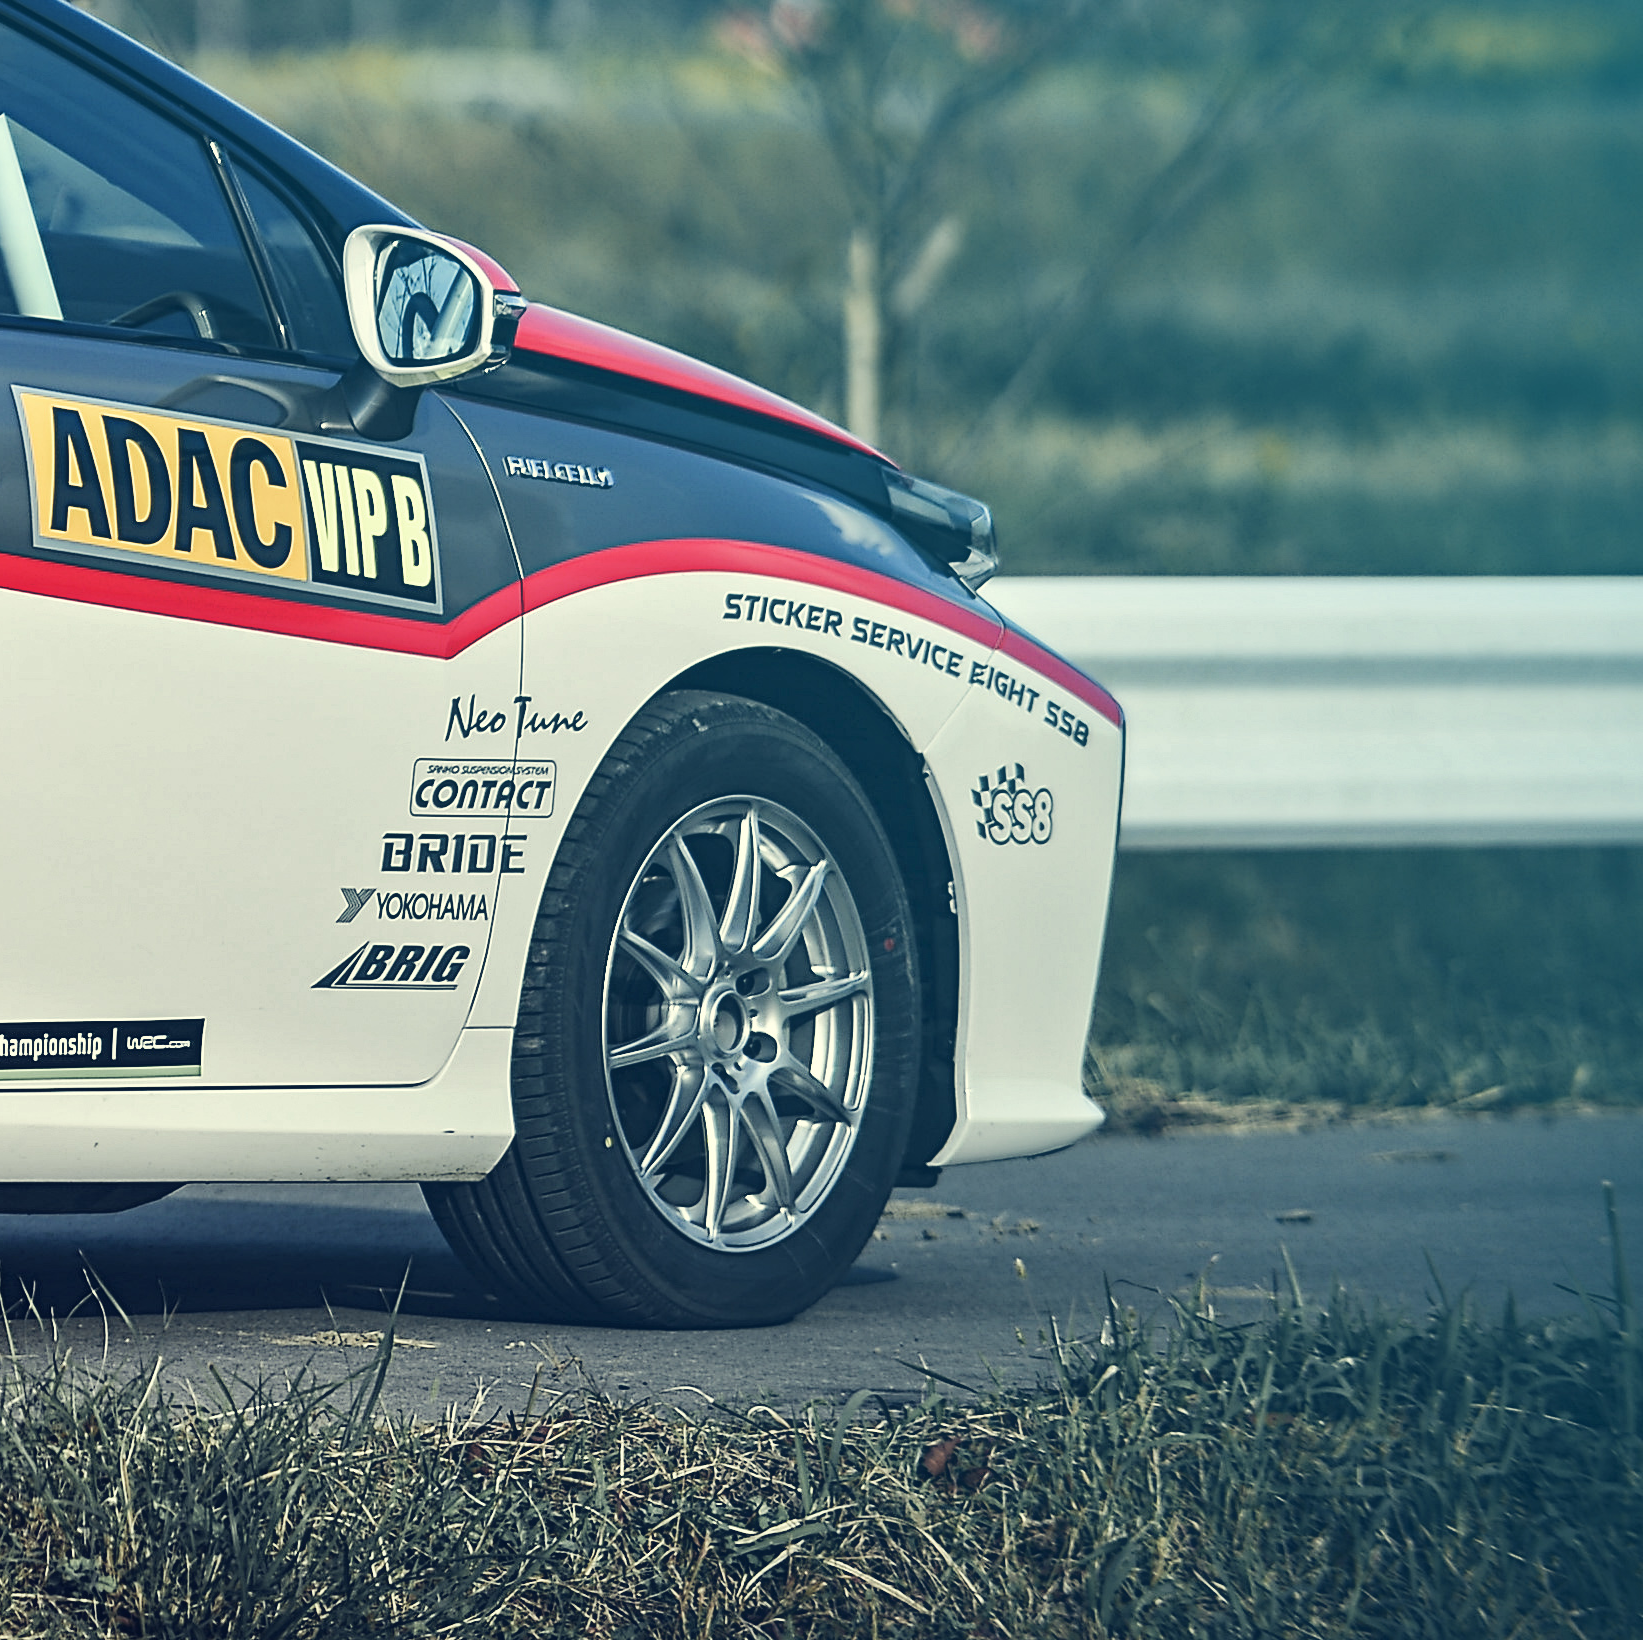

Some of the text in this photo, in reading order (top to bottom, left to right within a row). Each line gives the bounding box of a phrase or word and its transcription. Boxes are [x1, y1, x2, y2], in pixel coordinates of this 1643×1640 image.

[50, 406, 294, 570] ADAC
[303, 458, 388, 579] VIP
[723, 593, 844, 637] STICKER
[851, 617, 964, 677] SERVICE
[968, 660, 1041, 712] EIGHT
[445, 694, 589, 742] Neo Tune
[415, 779, 552, 809] CONTACT
[381, 833, 528, 874] BRIDE
[377, 893, 488, 921] YOKOHAMA
[353, 945, 471, 983] BRIG
